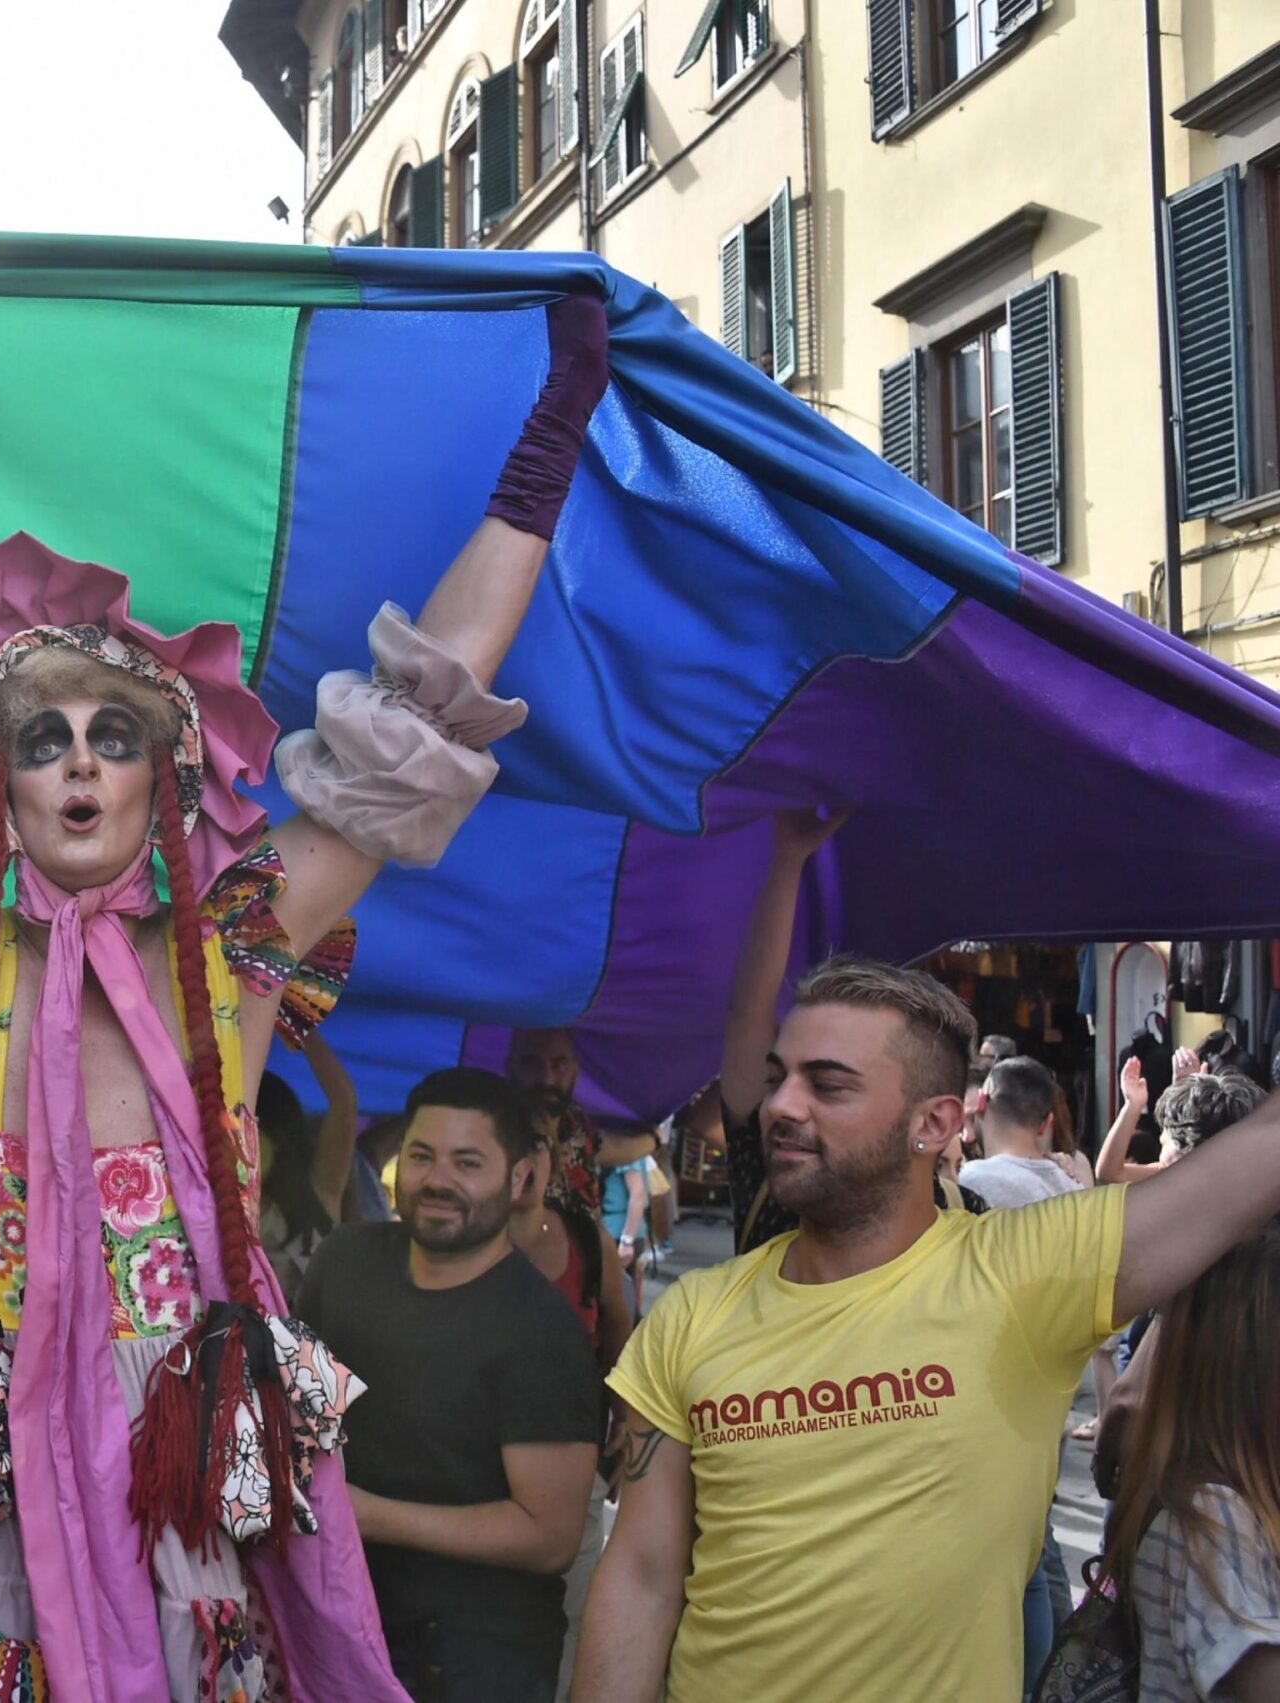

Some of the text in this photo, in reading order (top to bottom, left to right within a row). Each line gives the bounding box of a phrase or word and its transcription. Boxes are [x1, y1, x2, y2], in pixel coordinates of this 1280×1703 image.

[688, 1364, 956, 1436] mamamia
[702, 1401, 939, 1448] STRAORDINARIAMENTE NATURALI
